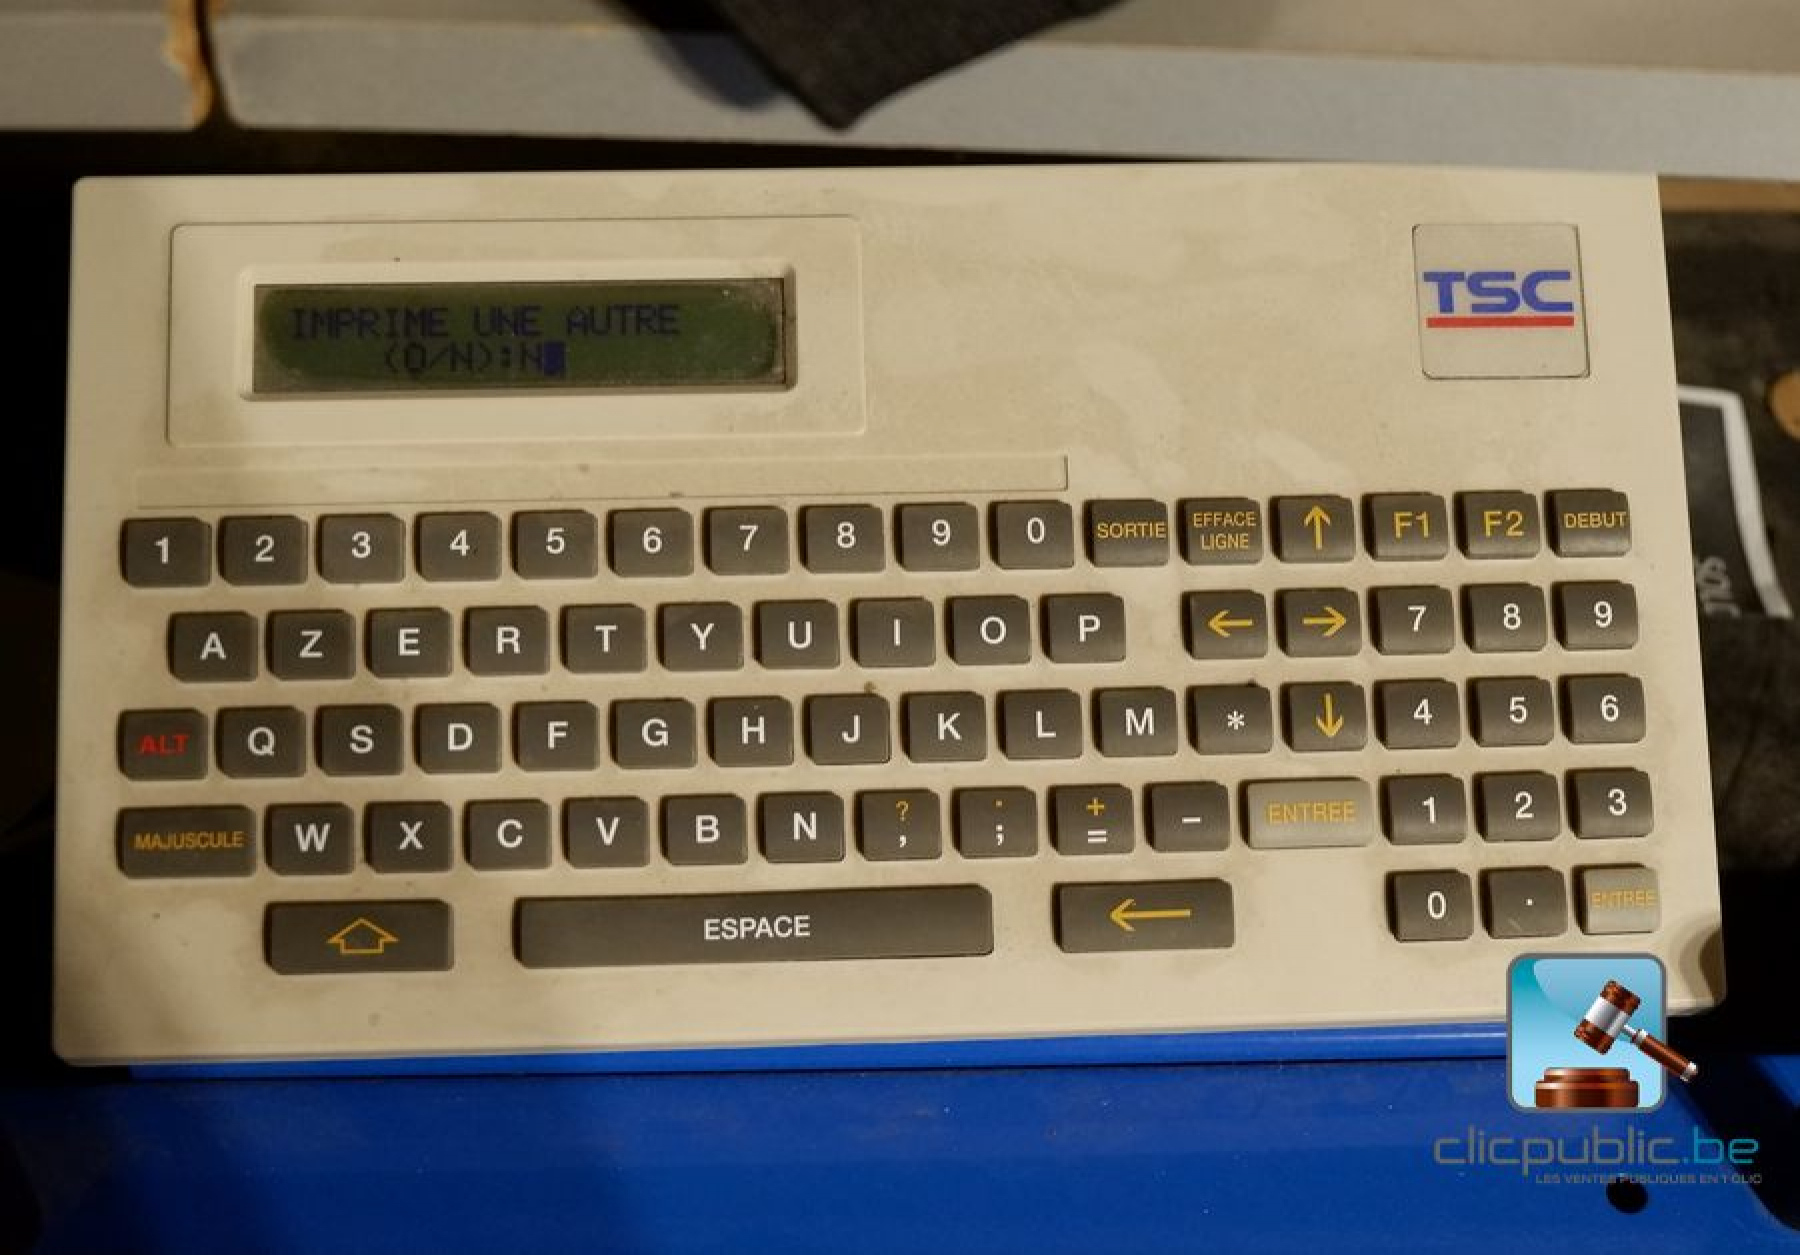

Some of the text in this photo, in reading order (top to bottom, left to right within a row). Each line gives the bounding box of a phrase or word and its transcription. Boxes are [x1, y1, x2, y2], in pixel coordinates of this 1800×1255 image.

[1423, 270, 1574, 314] TSC
[290, 304, 681, 339] IMPRIME UNE AUTRE
[1028, 518, 1044, 543] 0
[1097, 520, 1167, 539] SORTIE
[1193, 511, 1256, 527] EFFACE
[1394, 511, 1430, 538] F1
[1484, 511, 1524, 537] F2
[1564, 512, 1626, 529] DEBUT
[352, 532, 370, 558] 3
[450, 530, 470, 556] 4
[546, 528, 564, 554] 5
[644, 527, 662, 553] 6
[740, 525, 758, 550] 7
[838, 522, 856, 548] 8
[932, 520, 950, 546] 9
[1202, 533, 1249, 551] LIGNE
[154, 537, 169, 564] 1
[256, 535, 274, 562] 2
[1408, 606, 1426, 632] 7
[1504, 604, 1520, 630] 8
[1594, 601, 1612, 628] 9
[400, 628, 420, 655] E
[498, 627, 520, 653] R
[596, 625, 616, 652] T
[692, 623, 714, 650] Y
[790, 622, 812, 649] U
[894, 619, 900, 645] I
[980, 617, 1006, 644] O
[1080, 615, 1100, 642] P
[200, 633, 226, 659] A
[300, 631, 322, 657] Z
[1126, 708, 1154, 735] M
[1414, 699, 1432, 725] 4
[1510, 697, 1526, 723] 5
[1602, 695, 1618, 722] 6
[448, 723, 472, 751] D
[548, 721, 568, 748] F
[642, 719, 668, 746] G
[742, 717, 764, 744] H
[842, 715, 860, 743] J
[938, 713, 960, 740] K
[1036, 711, 1056, 738] L
[138, 734, 189, 755] ALT
[248, 727, 274, 755] Q
[350, 725, 374, 753] S
[1267, 801, 1356, 825] ENTREE
[1423, 797, 1437, 824] 1
[1516, 792, 1534, 819] 2
[1608, 789, 1626, 816] 3
[296, 824, 330, 851] W
[400, 822, 422, 849] X
[498, 819, 522, 848] C
[596, 817, 618, 845] V
[696, 815, 720, 843] B
[794, 813, 816, 840] N
[134, 831, 244, 851] MAJUSCULE
[1428, 892, 1446, 919] 0
[1592, 888, 1656, 908] ENTREE
[704, 915, 810, 939] ESPACE
